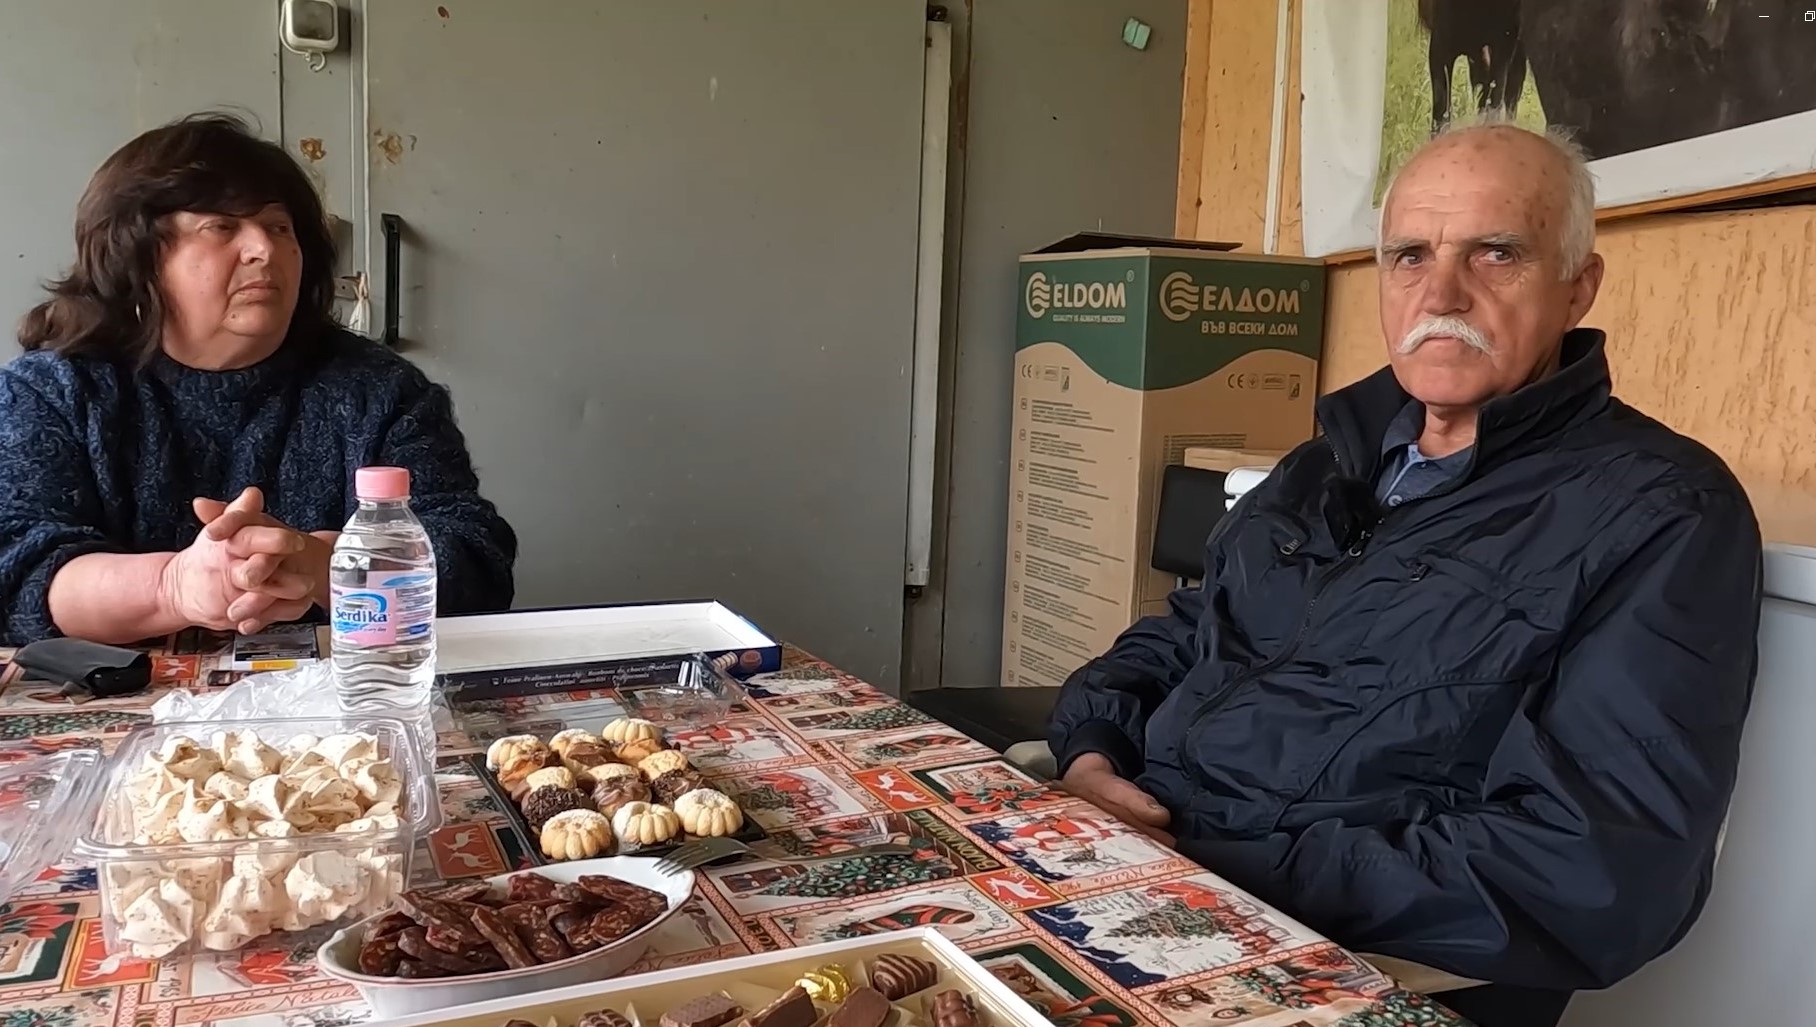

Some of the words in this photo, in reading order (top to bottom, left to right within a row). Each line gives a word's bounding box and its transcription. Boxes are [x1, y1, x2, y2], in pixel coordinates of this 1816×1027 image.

[1053, 282, 1126, 309] ELDOM
[1202, 285, 1300, 314] ЕЛДОМ
[1201, 320, 1226, 333] ВЪВ
[1229, 321, 1265, 335] ВСЕКИ
[1268, 323, 1298, 335] ДОМ
[335, 607, 388, 623] Serdika
[954, 840, 1001, 871] BUON
[186, 999, 267, 1022] Felice
[272, 986, 362, 1010] Natale
